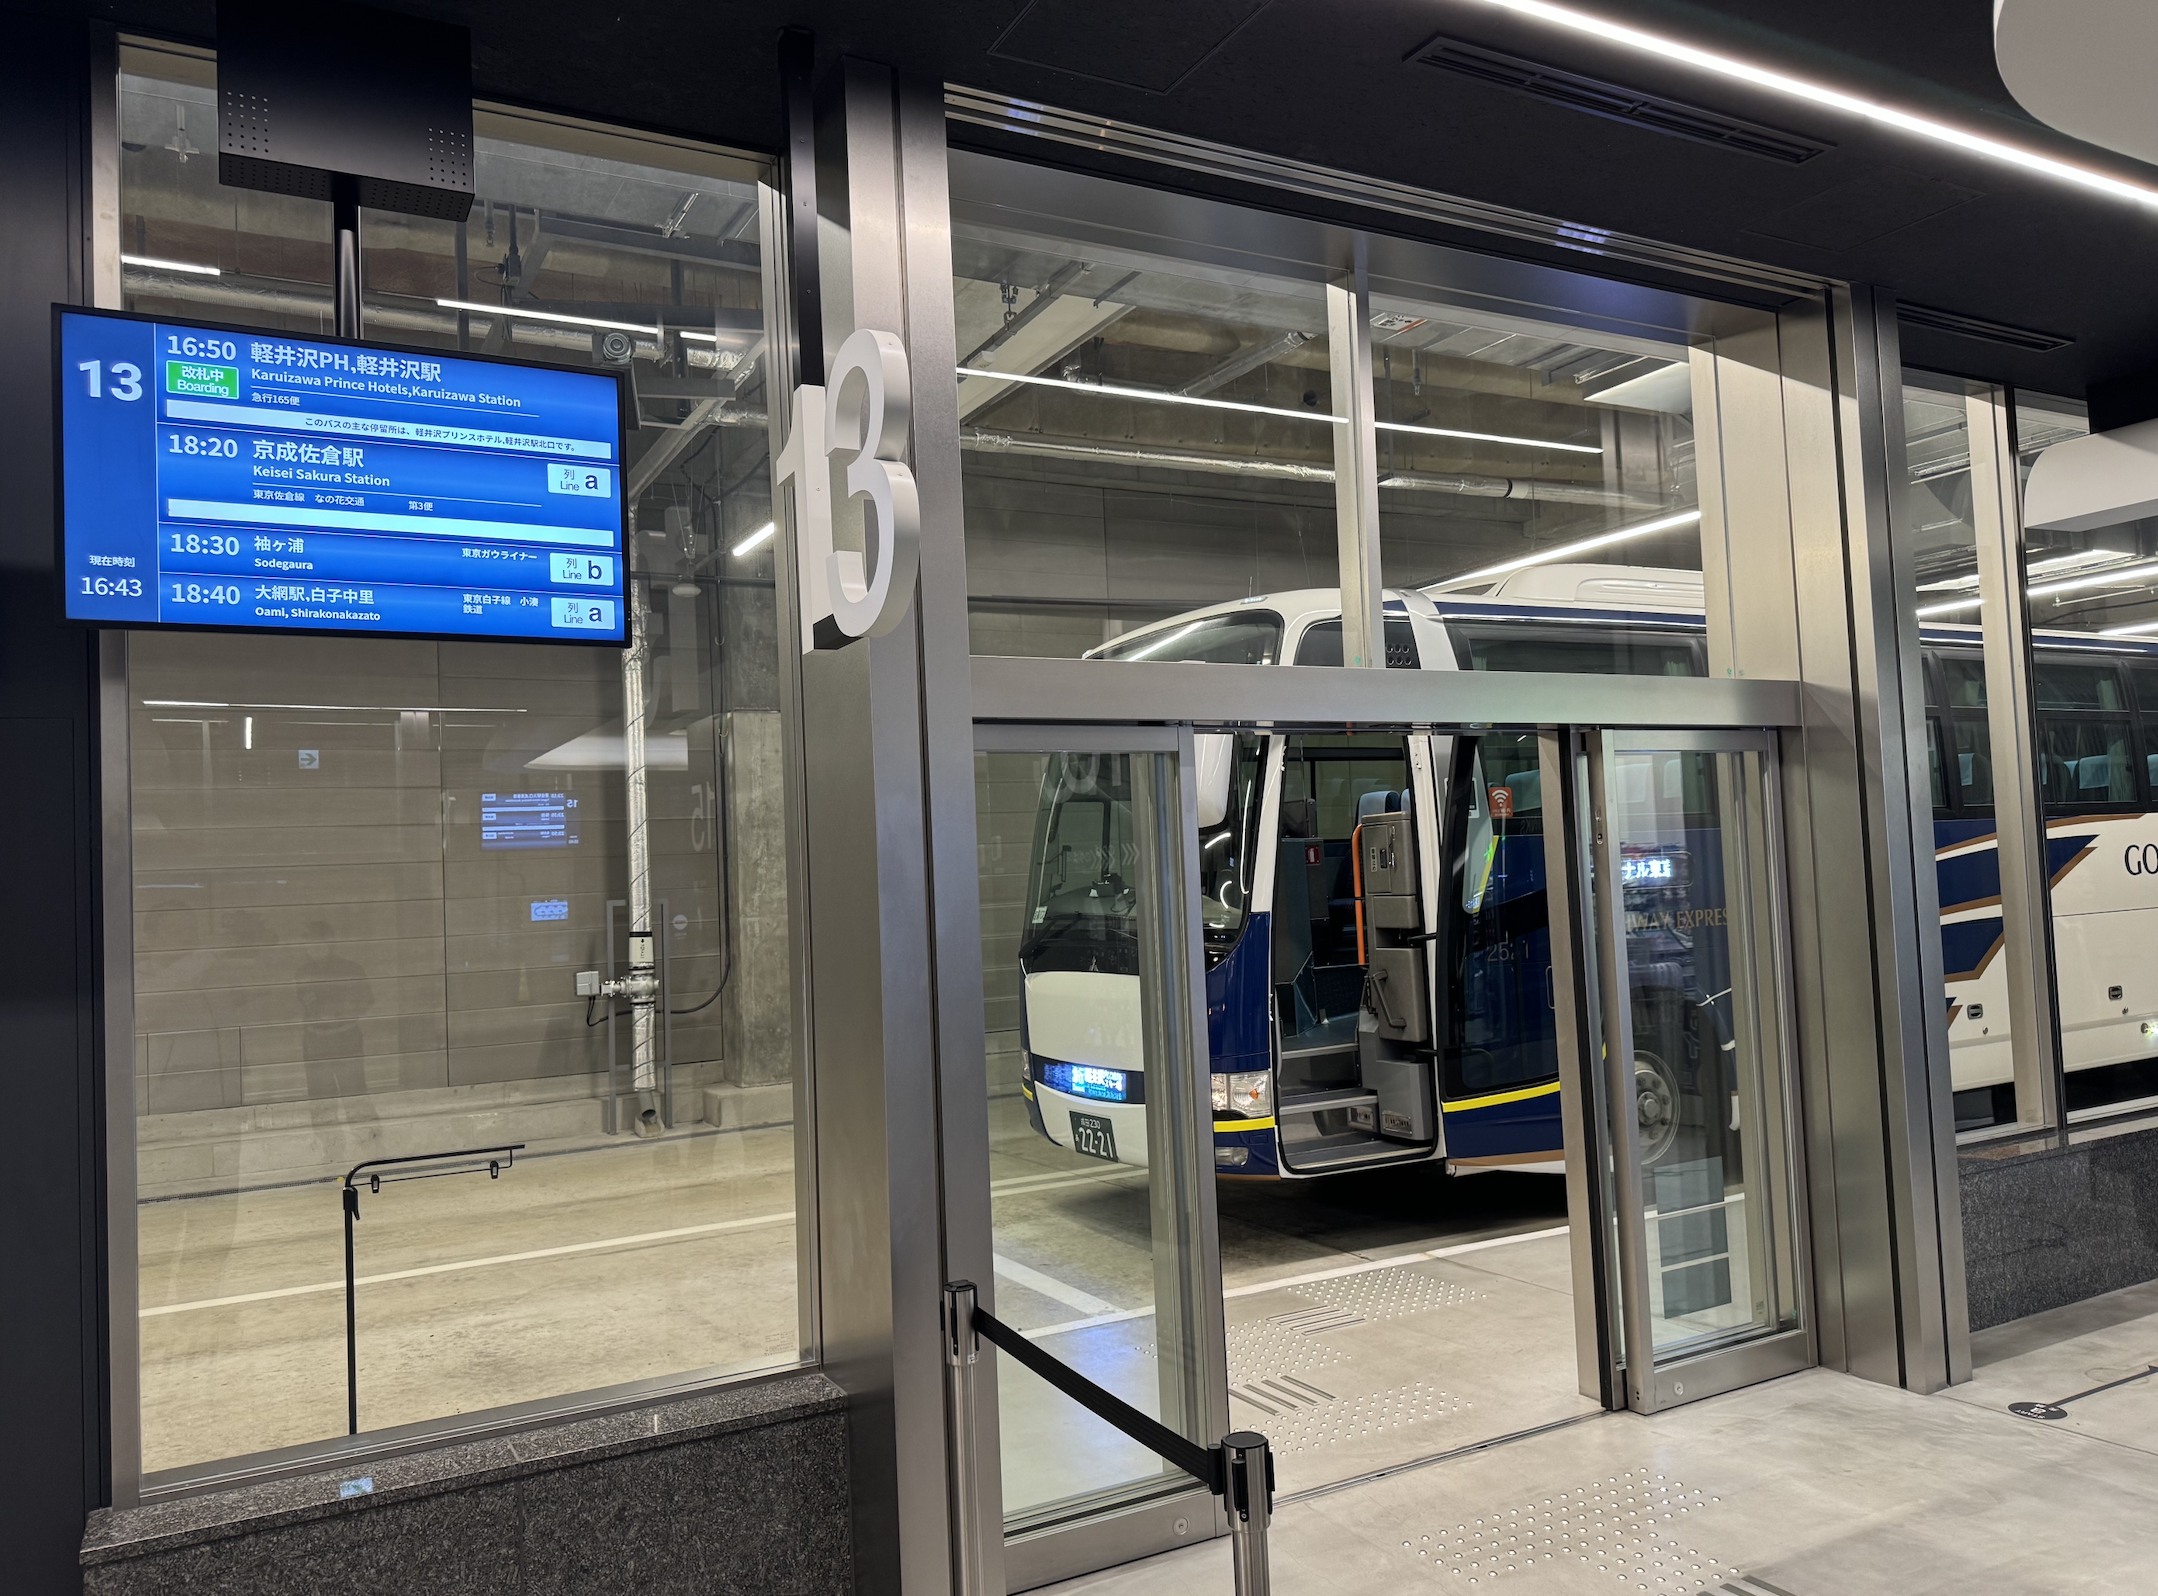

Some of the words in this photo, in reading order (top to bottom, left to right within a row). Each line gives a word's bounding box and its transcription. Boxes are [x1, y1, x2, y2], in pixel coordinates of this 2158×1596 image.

[167, 335, 237, 361] 16:50
[251, 342, 442, 383] 軽井沢PH,軽井沢駅
[79, 360, 143, 402] 13
[182, 365, 224, 381] 改札中
[177, 380, 229, 397] Boarding
[251, 368, 321, 386] Karuizawa
[324, 377, 365, 391] Prince
[478, 393, 521, 407] Station
[251, 391, 301, 406] 急行165便
[169, 434, 238, 459] 18:20
[252, 439, 365, 469] 京成佐倉駅
[253, 465, 293, 480] Keisei
[296, 469, 342, 483] Sakura
[344, 472, 391, 487] Station
[560, 480, 580, 492] Line
[585, 474, 599, 490] a
[564, 469, 575, 481] 列
[253, 489, 305, 502] 東京佐倉線
[315, 494, 365, 507] なの花交通
[409, 500, 433, 512] 第3便
[776, 329, 920, 655] 13
[170, 533, 240, 557] 18:30
[462, 548, 538, 561] 東京ガウライナー
[89, 555, 135, 568] 現在時刻
[254, 557, 313, 571] Sodegaura
[562, 569, 582, 580] Line
[588, 560, 603, 580] b
[566, 557, 577, 570] 列
[81, 577, 143, 597] 16:43
[171, 583, 241, 606] 18:40
[255, 585, 375, 606] 大網駅,白子中里
[463, 593, 511, 606] 東京白子線
[567, 602, 579, 614] 列
[255, 606, 289, 619] Oami,
[291, 608, 381, 622] Shirakonakazato
[463, 604, 483, 615] 鉄道
[564, 614, 584, 625] Line
[588, 606, 603, 622] a
